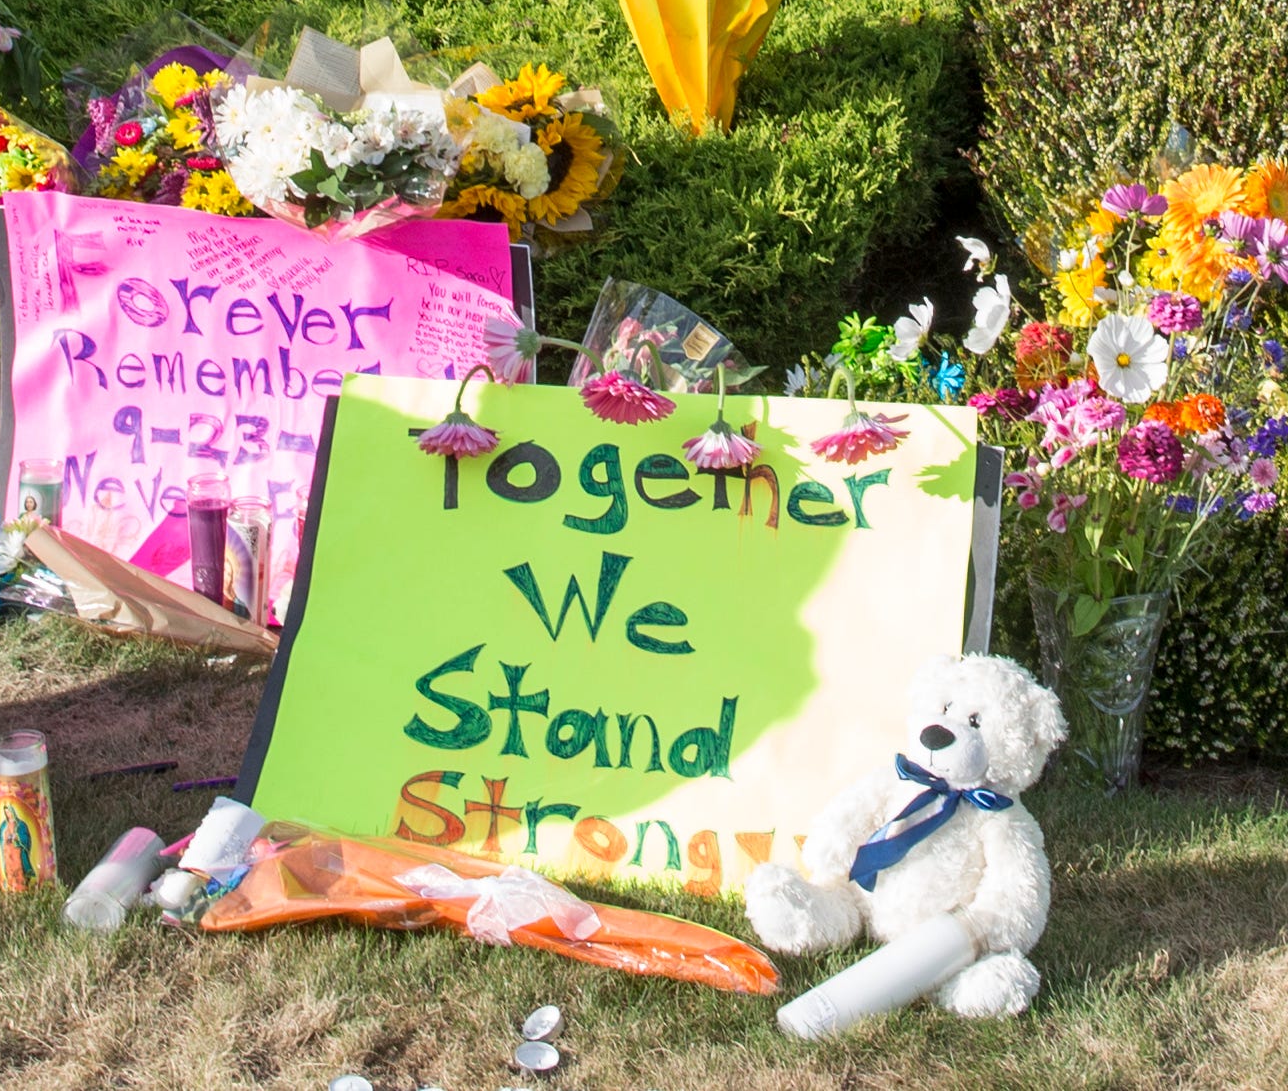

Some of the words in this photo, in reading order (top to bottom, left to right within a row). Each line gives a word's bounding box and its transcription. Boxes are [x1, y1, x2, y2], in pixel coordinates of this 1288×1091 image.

[406, 255, 450, 276] RIP
[452, 292, 471, 303] will
[62, 448, 188, 522] Neve
[408, 420, 891, 535] Together
[502, 550, 697, 656] We
[402, 642, 740, 781] Stand
